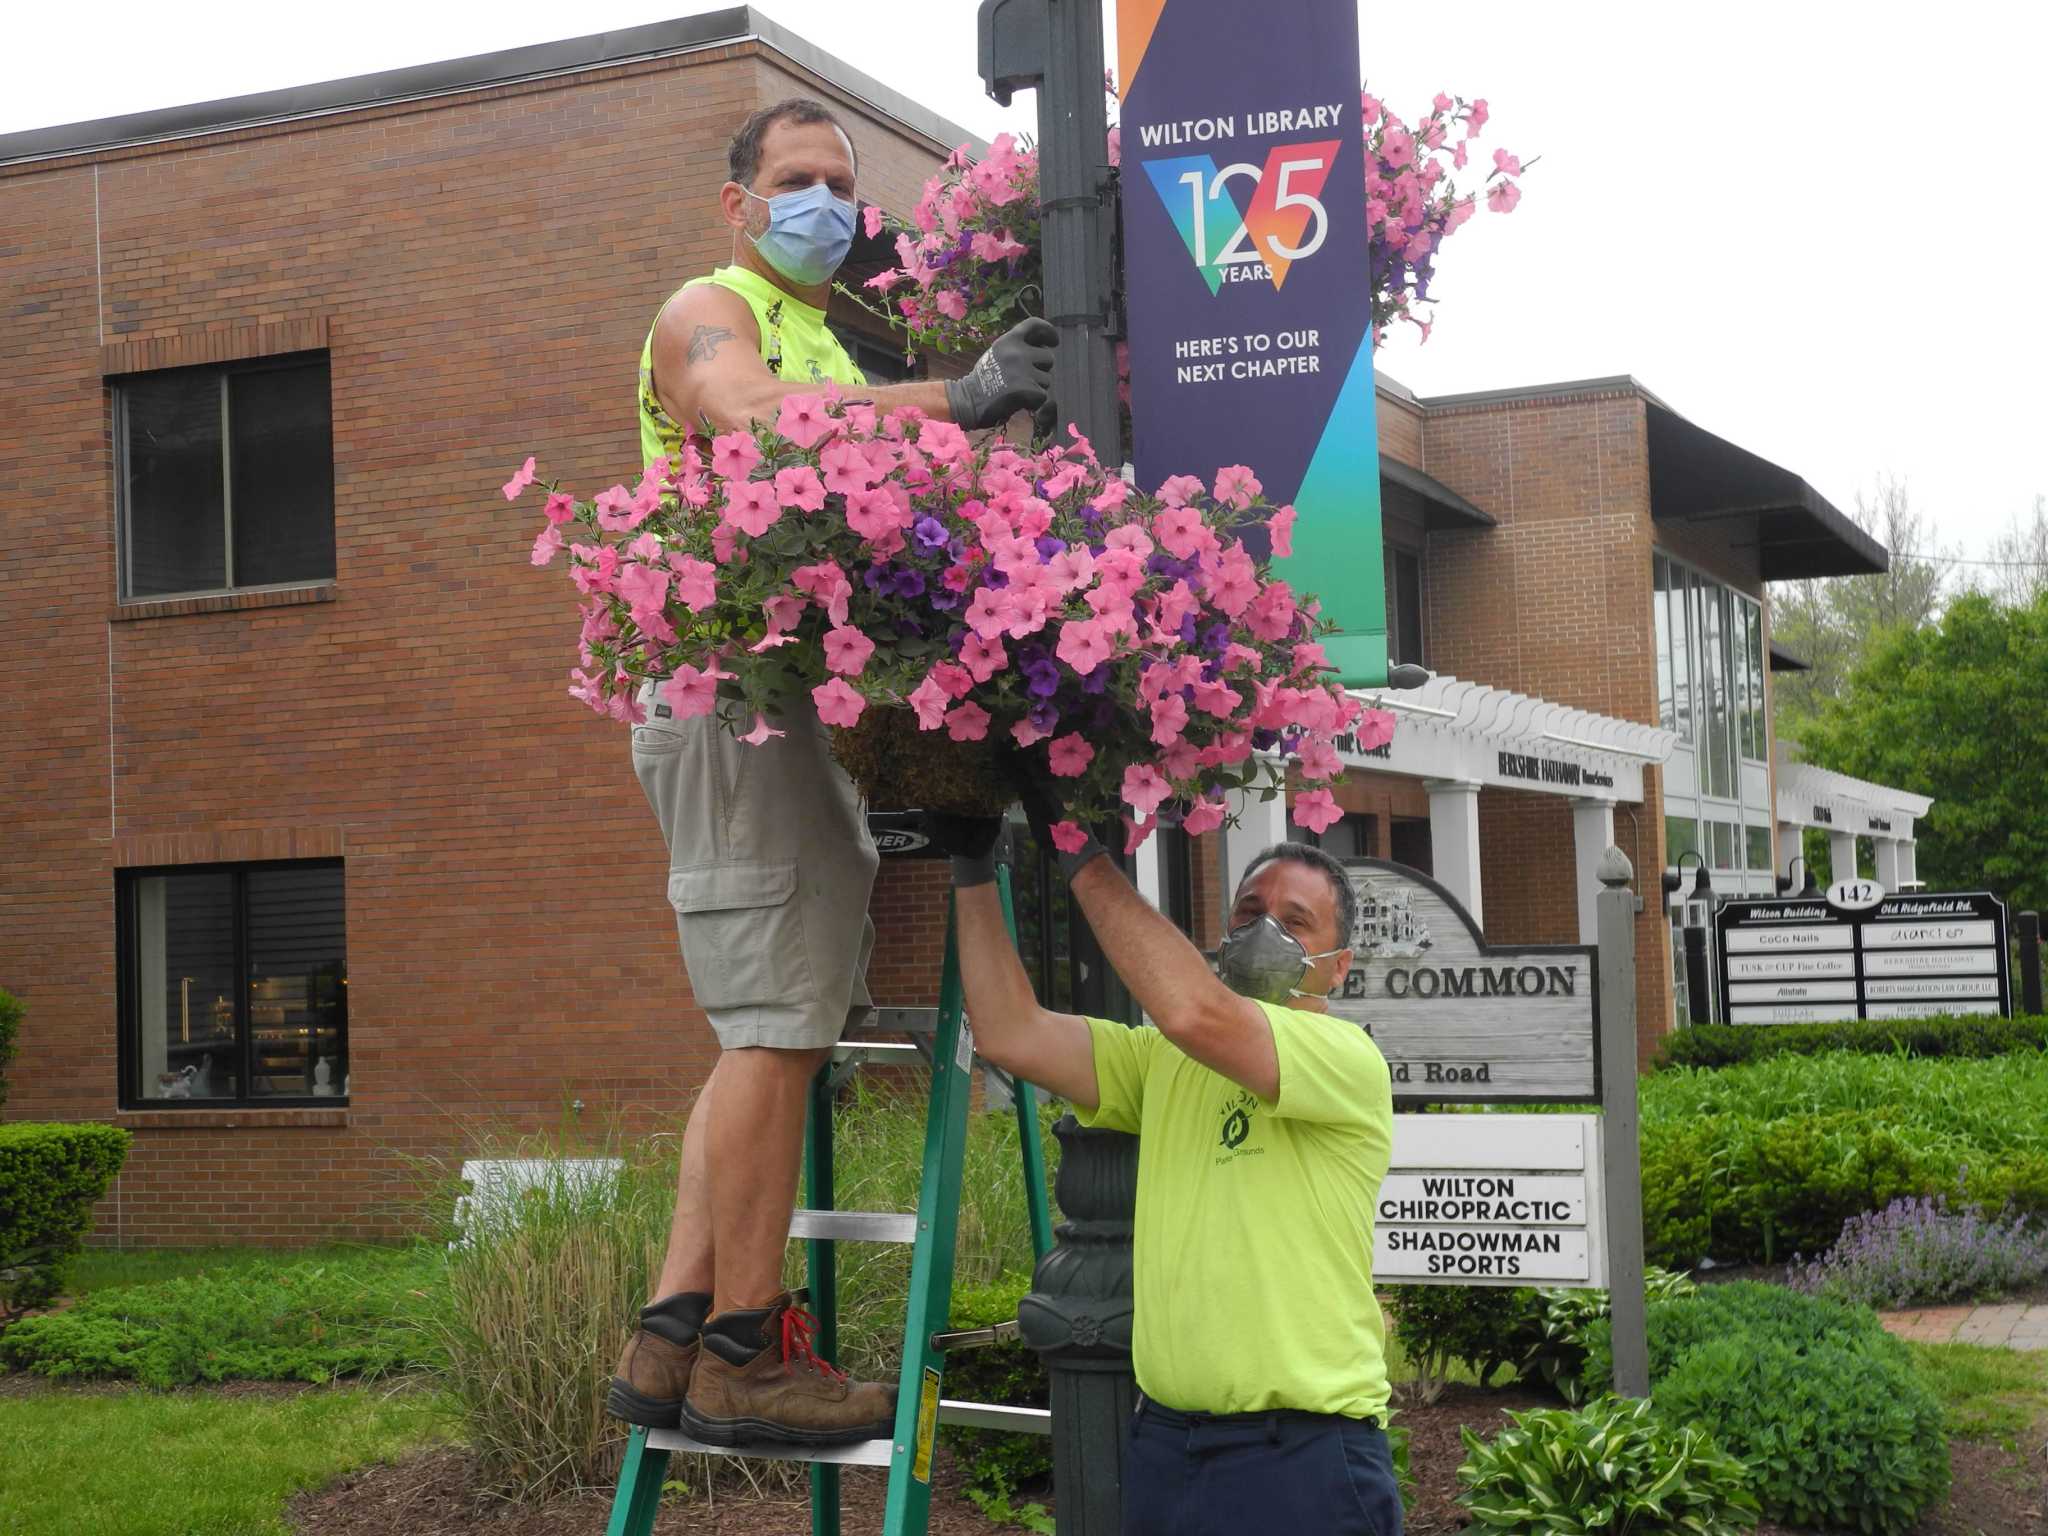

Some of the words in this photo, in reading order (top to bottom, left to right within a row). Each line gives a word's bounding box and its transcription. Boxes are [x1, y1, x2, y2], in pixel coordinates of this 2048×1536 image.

[1140, 116, 1235, 147] WILTON
[1247, 104, 1343, 136] LIBRARY
[1178, 158, 1329, 268] 125
[1219, 264, 1273, 283] YEARS
[1175, 336, 1238, 358] HERE'S
[1244, 334, 1270, 353] TO
[1276, 330, 1320, 349] OUR
[1177, 364, 1225, 384] NEXT
[1231, 356, 1320, 379] CHAPTER
[1498, 751, 1540, 780] BERKSHIRE
[1540, 759, 1581, 786] HATHAWAY
[1839, 884, 1873, 903] 142
[1783, 904, 1827, 919] Building
[1880, 903, 1899, 915] Old
[1900, 901, 1955, 916] Ridgefield
[1955, 900, 1973, 912] Rd.
[1759, 935, 1789, 944] CoCo
[1792, 932, 1820, 943] Nails
[1384, 966, 1577, 999] COMMON
[1424, 1062, 1491, 1084] Road
[1422, 1178, 1514, 1198] WILTON
[1379, 1200, 1571, 1221] CHIROPRACTIC
[1388, 1231, 1560, 1253] SHADOWMAN
[1428, 1254, 1521, 1275] SPORTS
